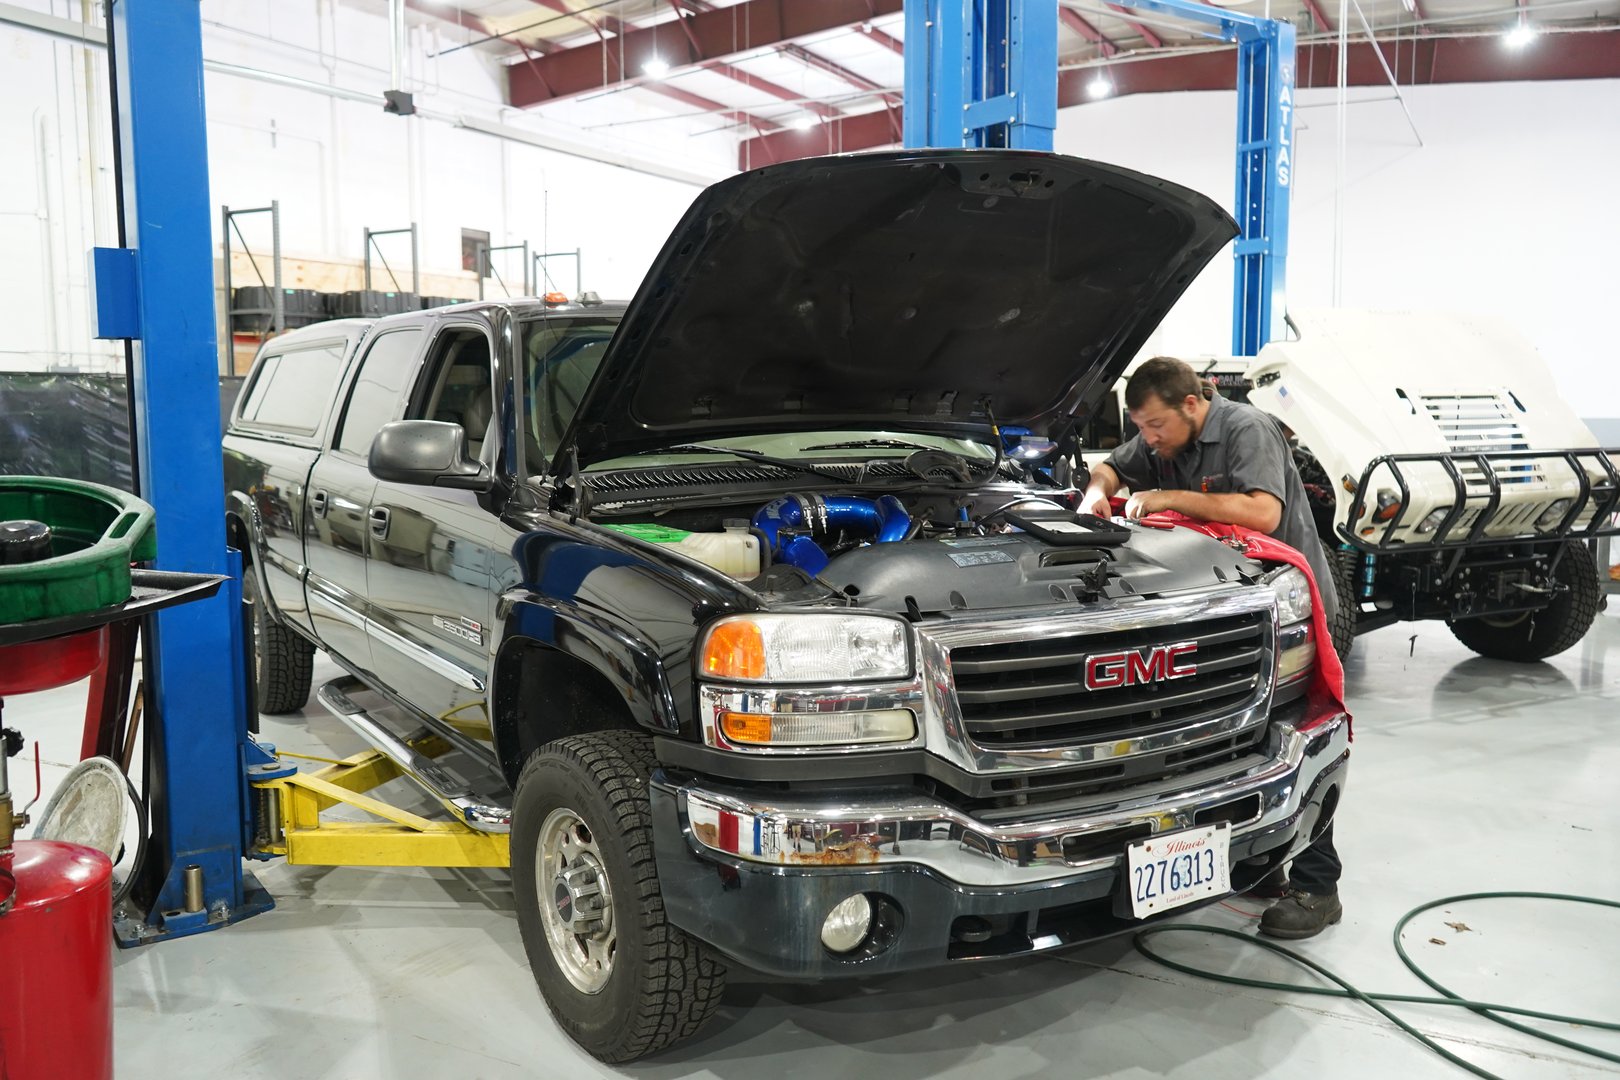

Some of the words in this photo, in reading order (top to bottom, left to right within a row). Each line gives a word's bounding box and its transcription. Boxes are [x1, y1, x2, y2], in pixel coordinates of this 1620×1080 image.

[1278, 86, 1292, 186] ATLAS
[1085, 641, 1197, 691] GMC
[1160, 838, 1206, 857] Illinois
[1135, 848, 1214, 902] 2276313
